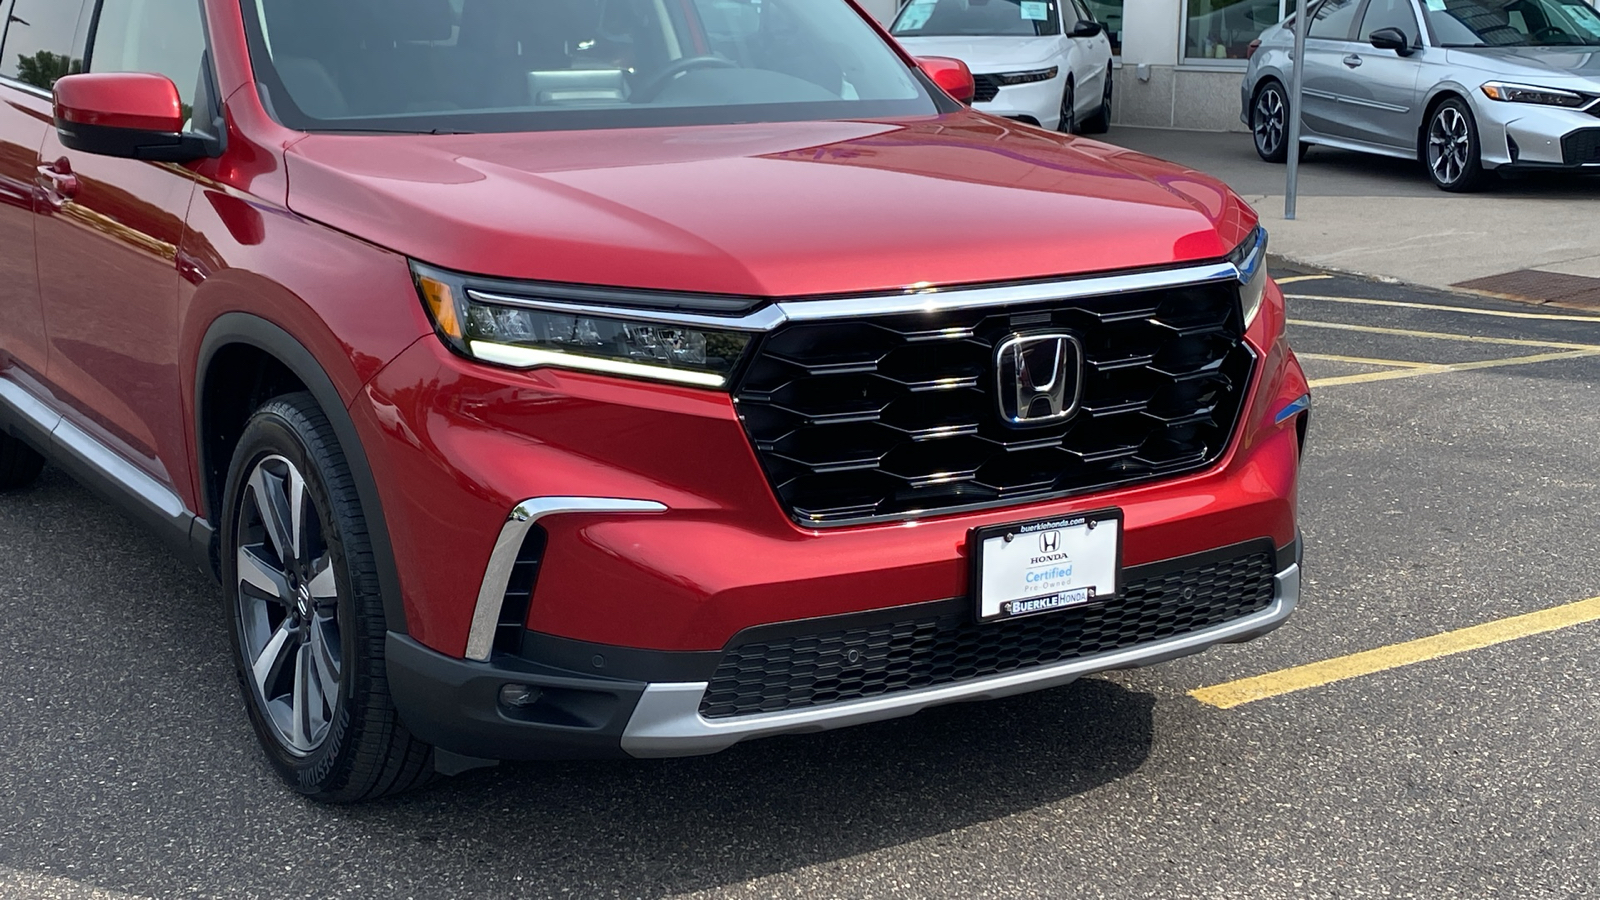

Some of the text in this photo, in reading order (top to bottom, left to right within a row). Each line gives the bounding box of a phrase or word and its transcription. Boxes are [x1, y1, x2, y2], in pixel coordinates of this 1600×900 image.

[1020, 517, 1085, 533] buerklehonda.com
[1030, 552, 1069, 564] HONDA
[1025, 564, 1073, 583] Certified
[1024, 577, 1072, 592] Pre-Owned
[1012, 592, 1086, 613] BUERKLE HONDA
